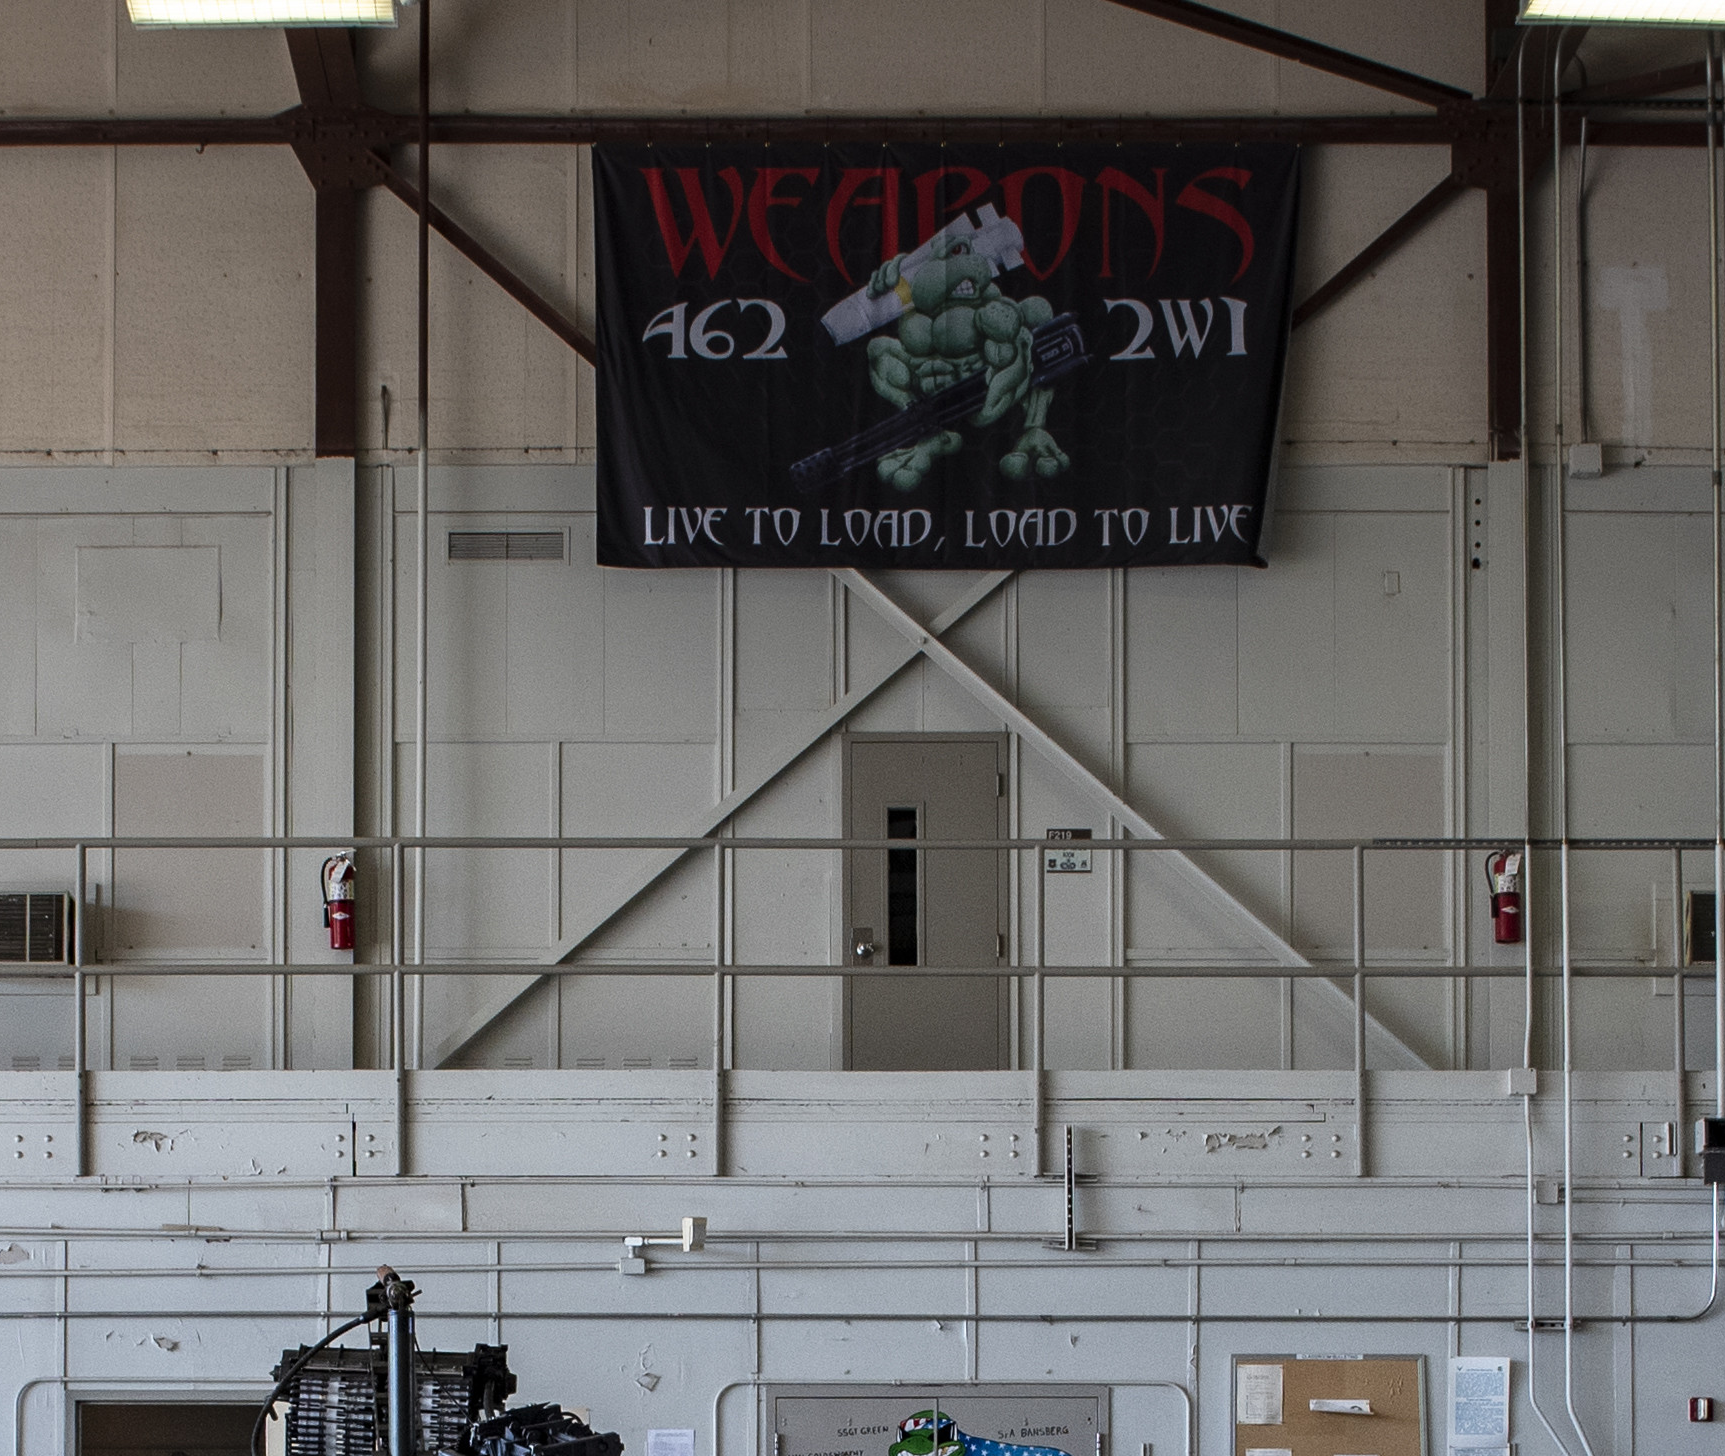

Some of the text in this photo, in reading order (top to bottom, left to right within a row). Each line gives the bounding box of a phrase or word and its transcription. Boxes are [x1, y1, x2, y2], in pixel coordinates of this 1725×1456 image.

[638, 166, 1256, 285] WEAPONS
[642, 299, 788, 360] 462
[643, 505, 1254, 551] LIVE TO LOAD, LOAD TO LIVE
[1048, 831, 1072, 840] F219
